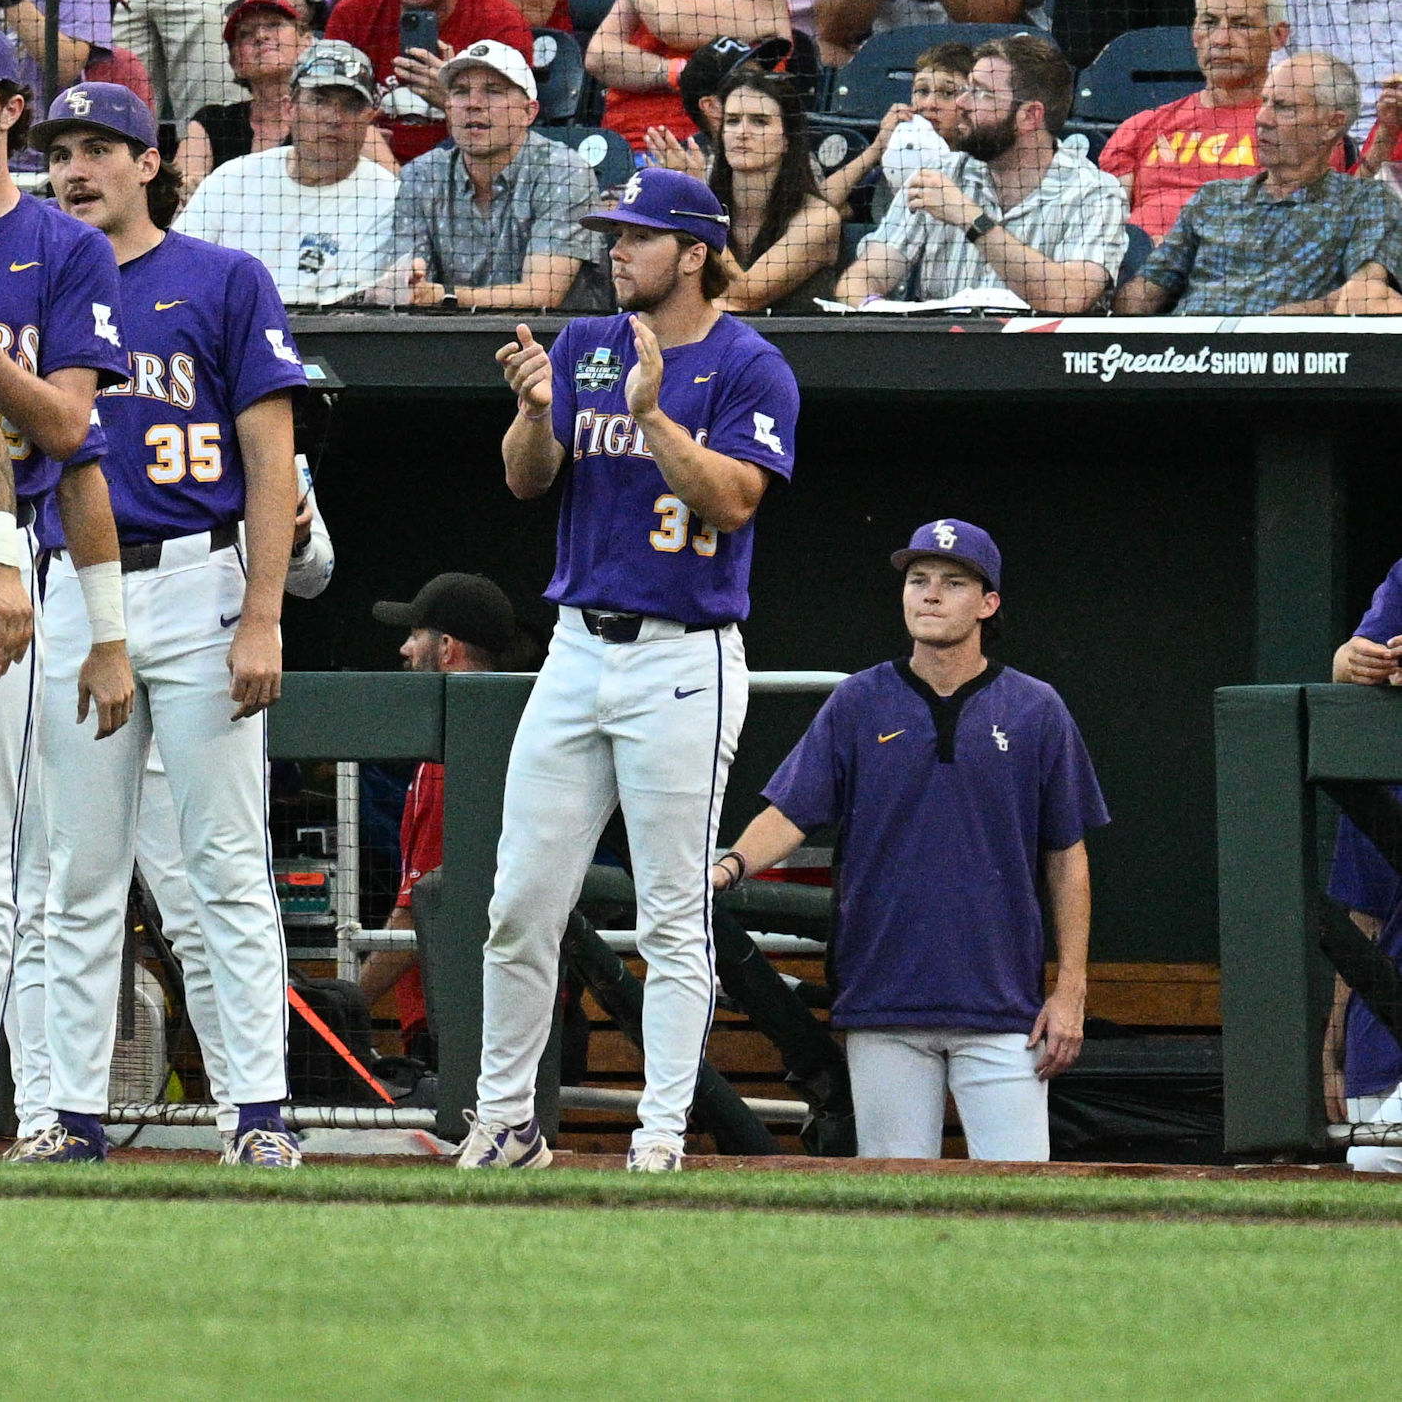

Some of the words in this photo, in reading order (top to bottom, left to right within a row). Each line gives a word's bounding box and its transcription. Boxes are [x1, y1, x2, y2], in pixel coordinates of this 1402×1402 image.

[63, 85, 94, 117] LSU
[1062, 351, 1099, 374] THE
[1098, 343, 1211, 383] Greatest
[1210, 352, 1268, 374] SHOW
[1272, 352, 1298, 374] ON
[1304, 352, 1350, 374] DIRT
[143, 422, 225, 484] 35
[931, 518, 958, 551] LSU
[991, 724, 1010, 752] LSU
